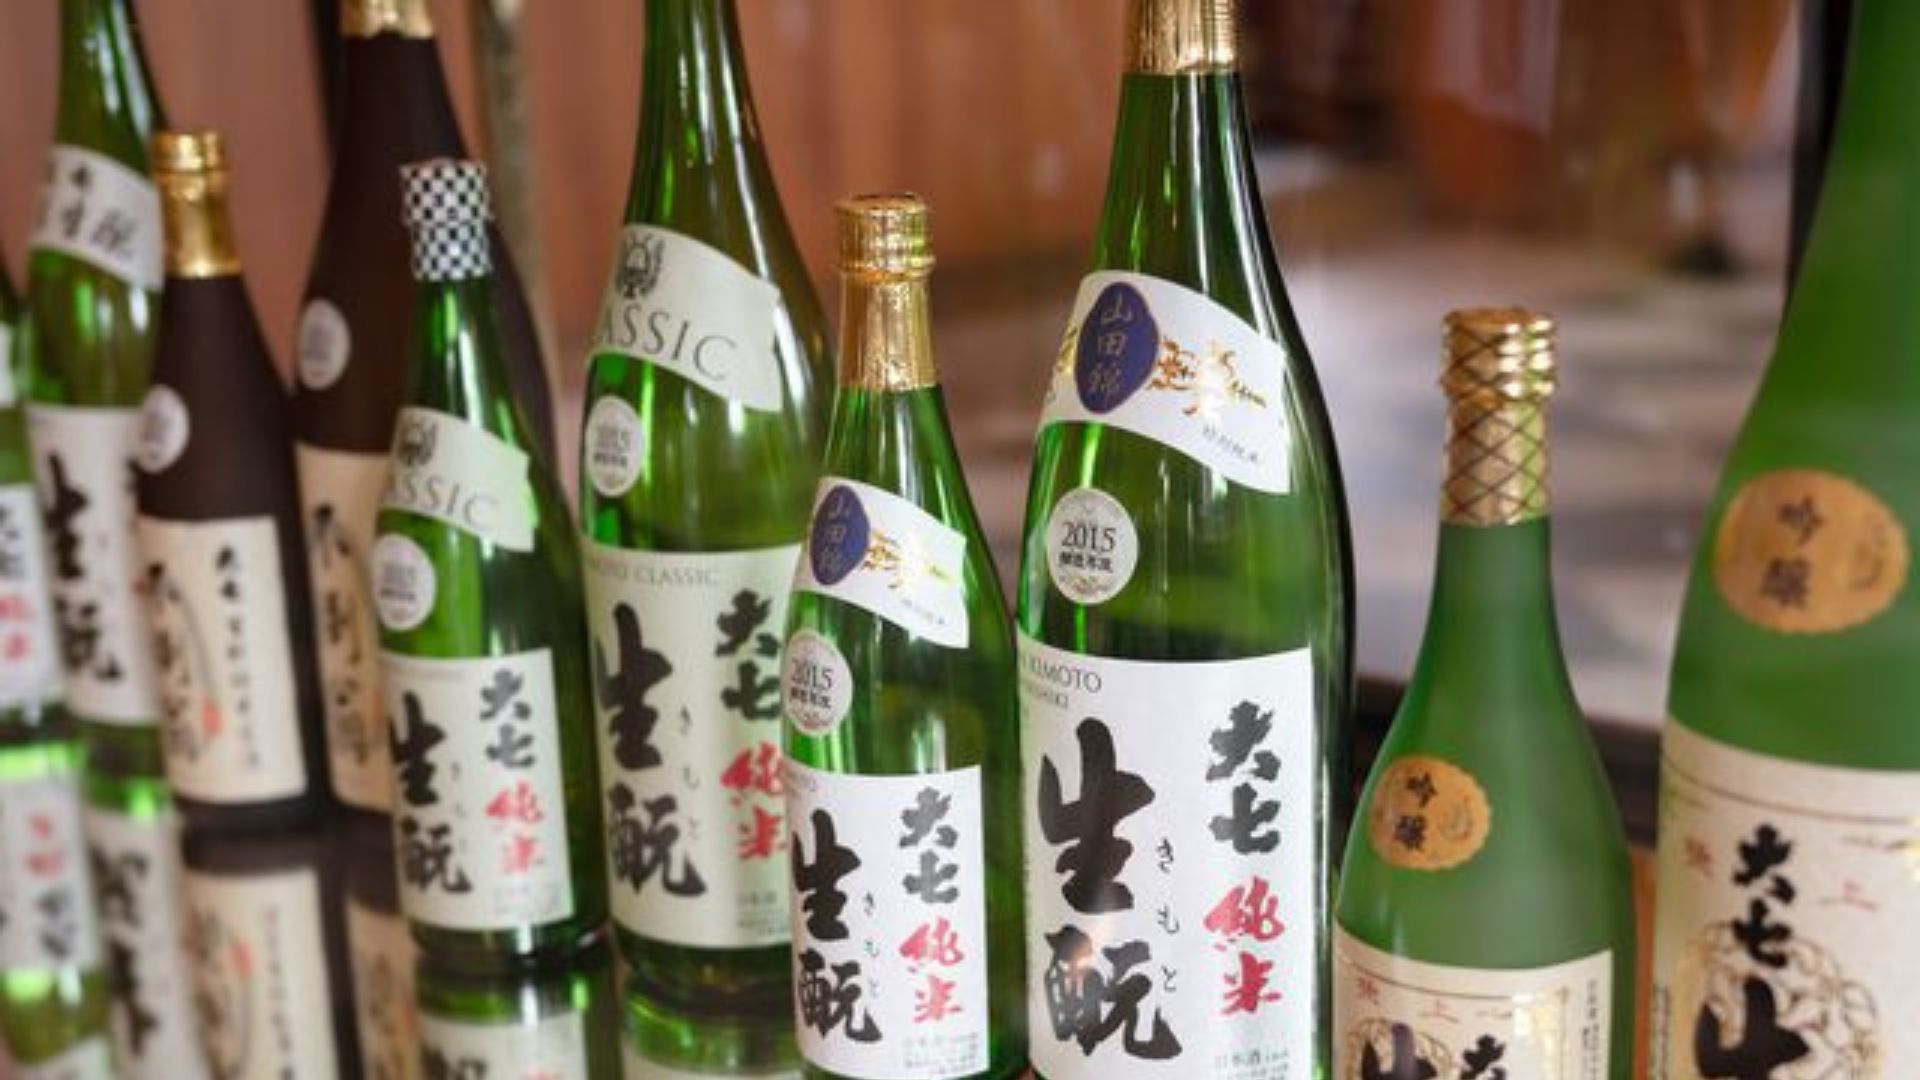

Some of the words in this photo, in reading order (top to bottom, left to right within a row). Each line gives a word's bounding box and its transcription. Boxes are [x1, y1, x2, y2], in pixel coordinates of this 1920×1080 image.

[1062, 521, 1117, 553] 2015
[480, 668, 535, 768] 大七
[1205, 700, 1282, 855] 大七
[899, 786, 959, 904] 大七
[1732, 823, 1796, 969] 大七
[899, 917, 965, 1024] 純米
[1156, 837, 1180, 993] きもと
[1204, 876, 1285, 1016] 純米
